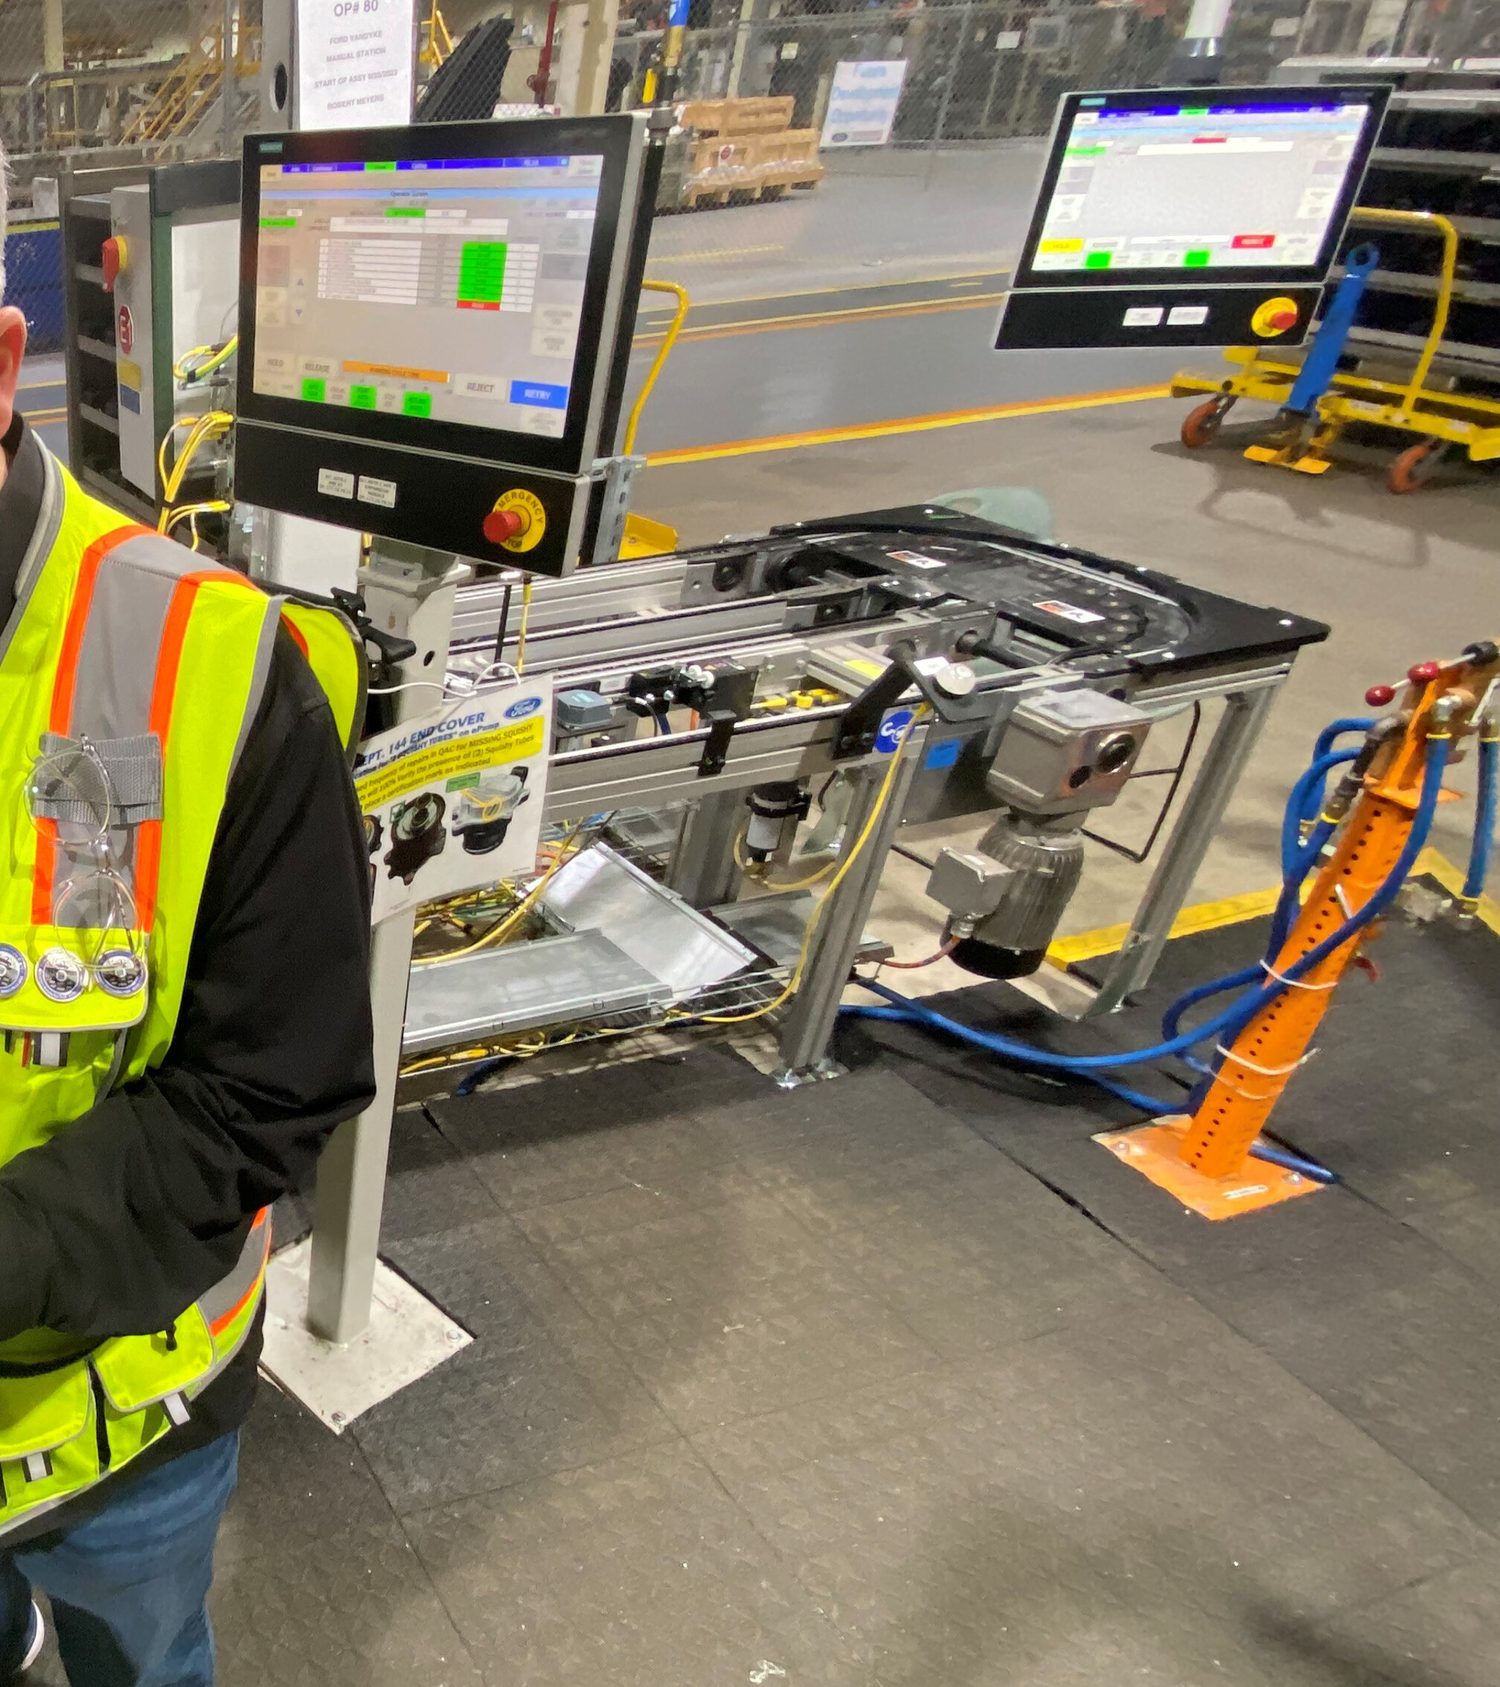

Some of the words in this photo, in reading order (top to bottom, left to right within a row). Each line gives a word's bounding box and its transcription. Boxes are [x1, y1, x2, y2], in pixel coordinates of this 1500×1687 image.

[334, 2, 360, 17] OP#
[363, 0, 379, 13] 80
[355, 47, 386, 59] STATION
[314, 79, 337, 89] START
[337, 76, 348, 85] OF
[466, 382, 495, 393] REJECT
[524, 389, 552, 400] RETRY
[496, 491, 544, 524] MERGENCY
[410, 726, 436, 745] END
[437, 712, 486, 732] COVER
[459, 728, 470, 737] on
[471, 722, 500, 735] ePump
[406, 753, 430, 767] repairs
[430, 750, 437, 759] in
[456, 743, 468, 751] for
[469, 733, 502, 748] MISSING
[503, 723, 534, 740] SQUISHY
[416, 764, 427, 773] the
[428, 754, 461, 769] presence
[463, 750, 471, 759] of
[472, 748, 484, 758] (2)
[485, 742, 513, 755] Squishy
[514, 735, 535, 746] Tubes
[424, 769, 443, 781] mark
[444, 766, 454, 775] as
[455, 757, 491, 771] indicated
